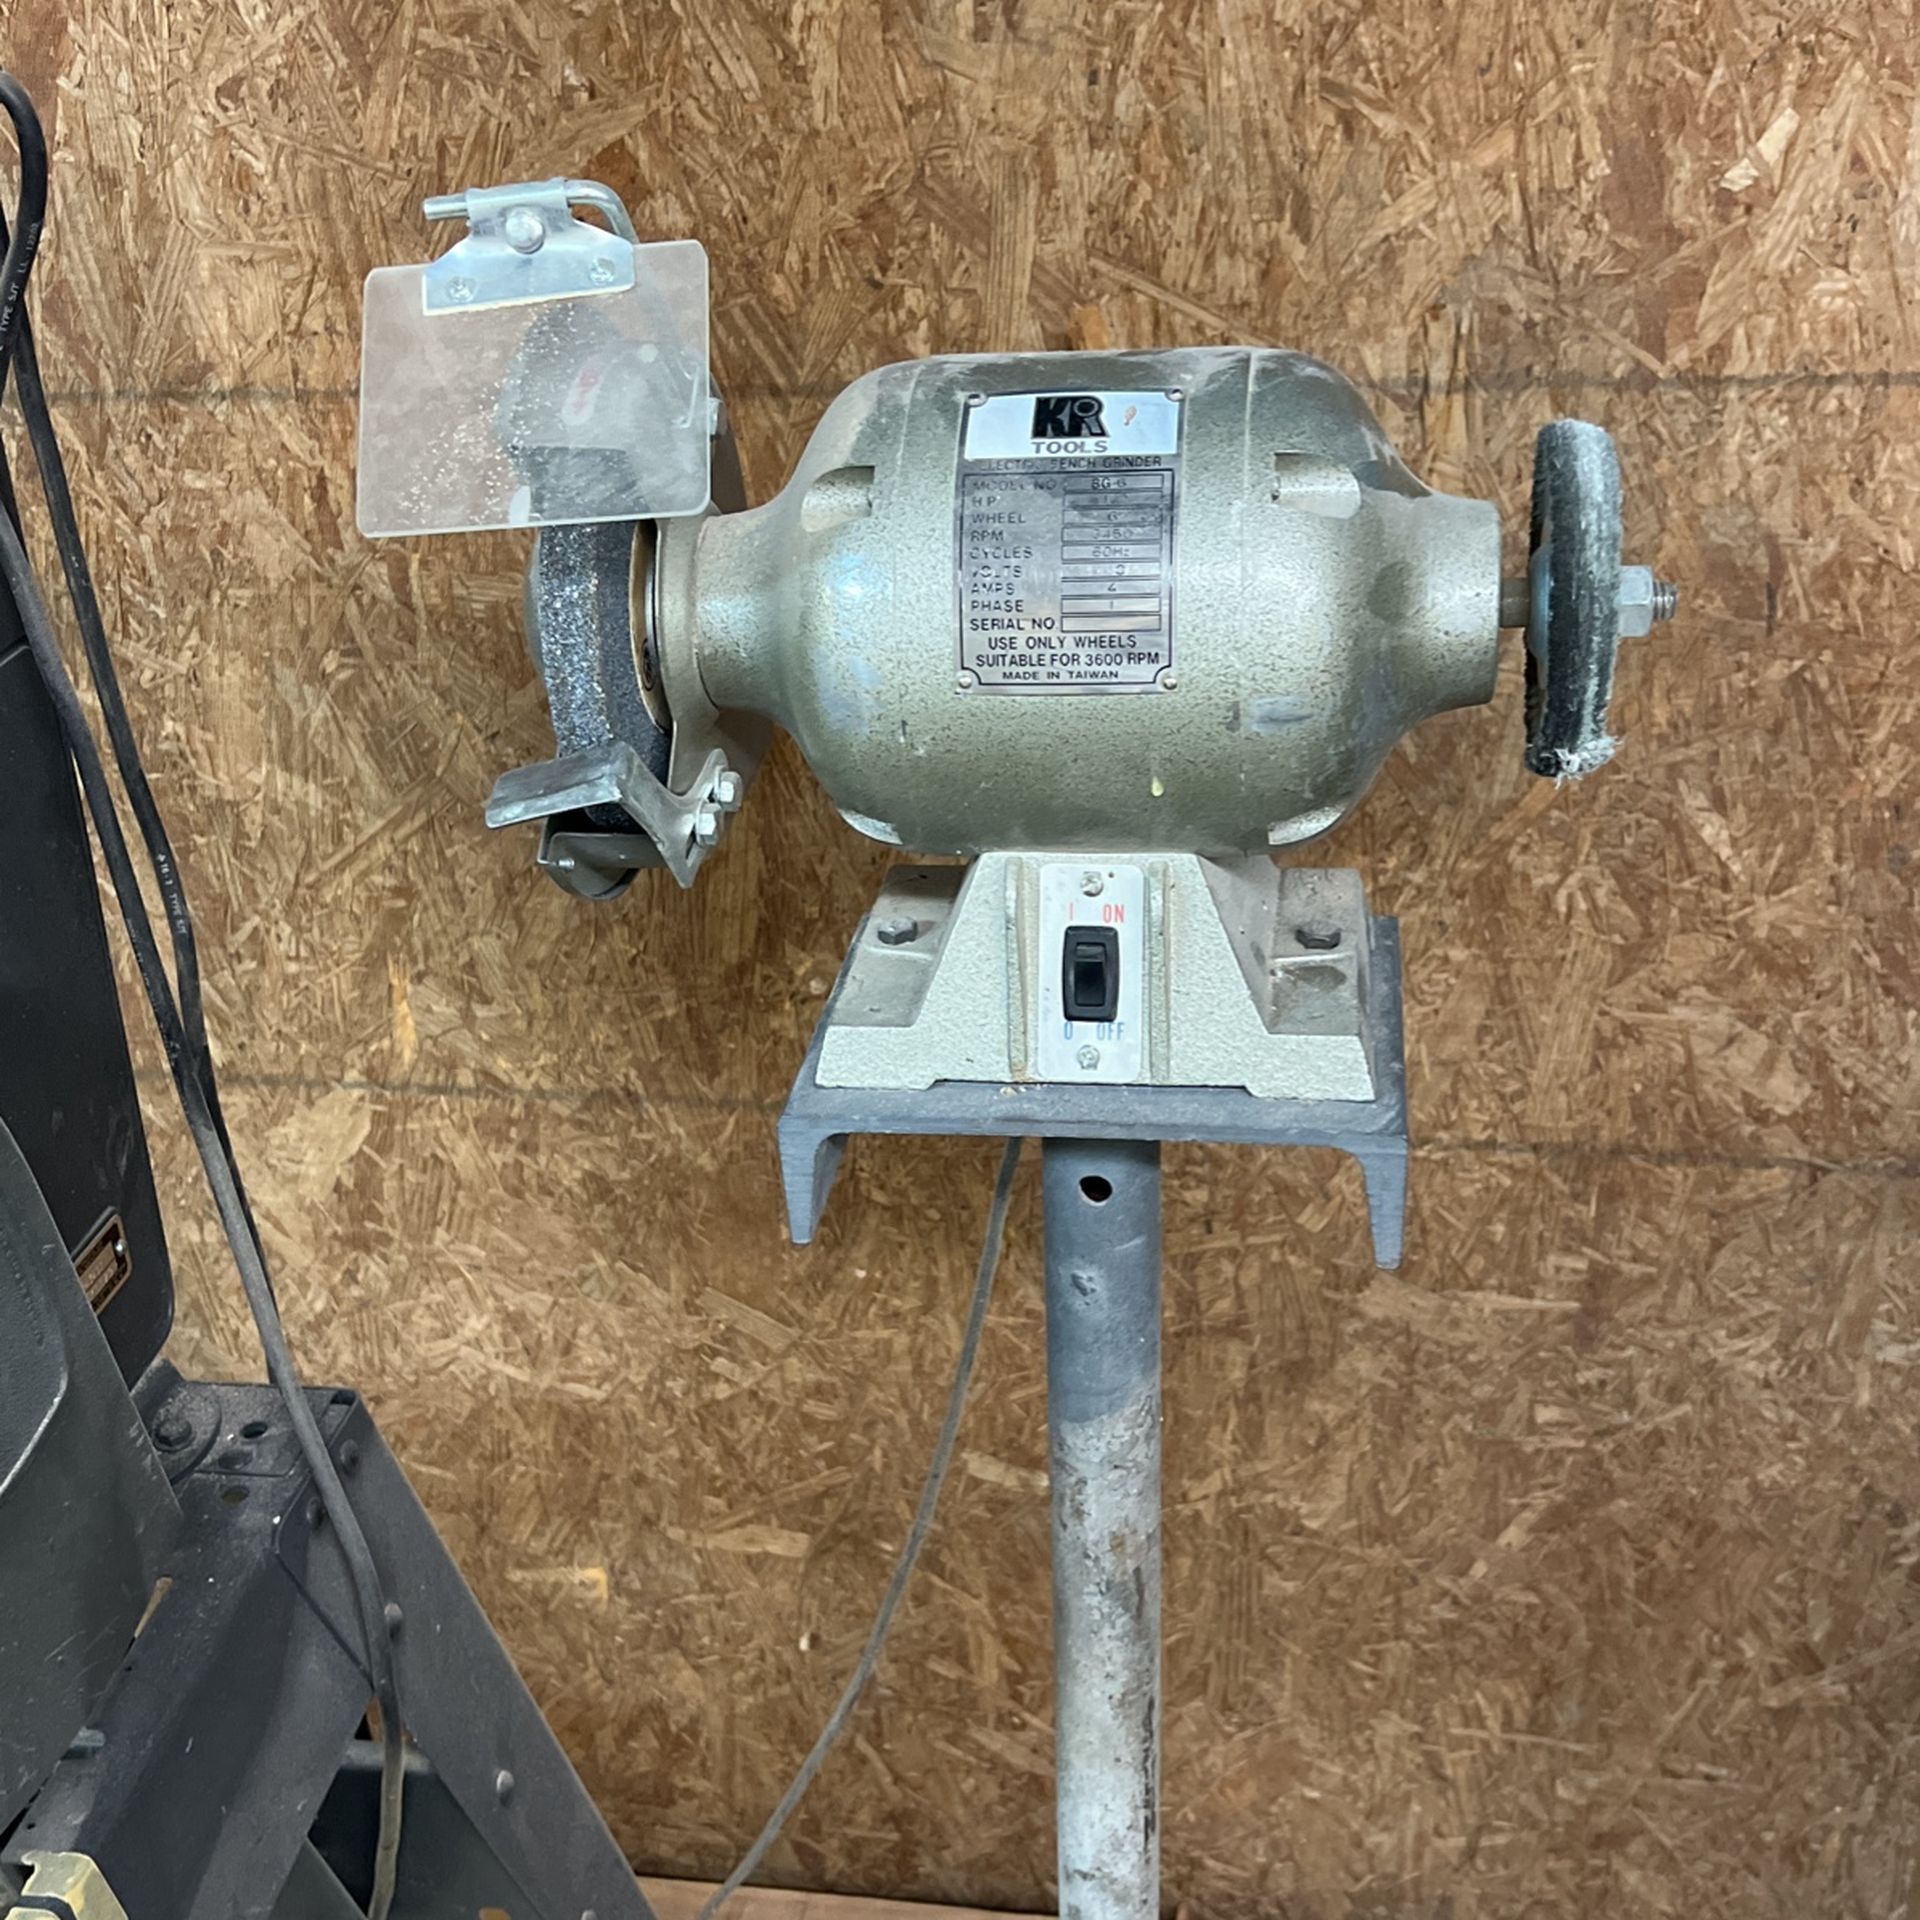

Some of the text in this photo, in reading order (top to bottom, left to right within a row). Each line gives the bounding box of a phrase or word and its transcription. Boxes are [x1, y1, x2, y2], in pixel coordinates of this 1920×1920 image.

[1032, 440, 1109, 454] TOOLS
[1102, 456, 1162, 468] GRINDER
[971, 512, 1027, 524] WHEEL
[970, 530, 1005, 542] RPM
[970, 546, 1033, 559] CYCLES
[971, 600, 1025, 613] PHASE
[970, 617, 1056, 631] SERIAL NO
[988, 635, 1137, 650] USE ONLY WHEELS
[976, 652, 1160, 667] SUITABLE FOR 3600 RPM
[1002, 670, 1118, 680] MADE IN TAIWAN
[1103, 904, 1125, 923] ON
[1096, 1022, 1125, 1040] OFF
